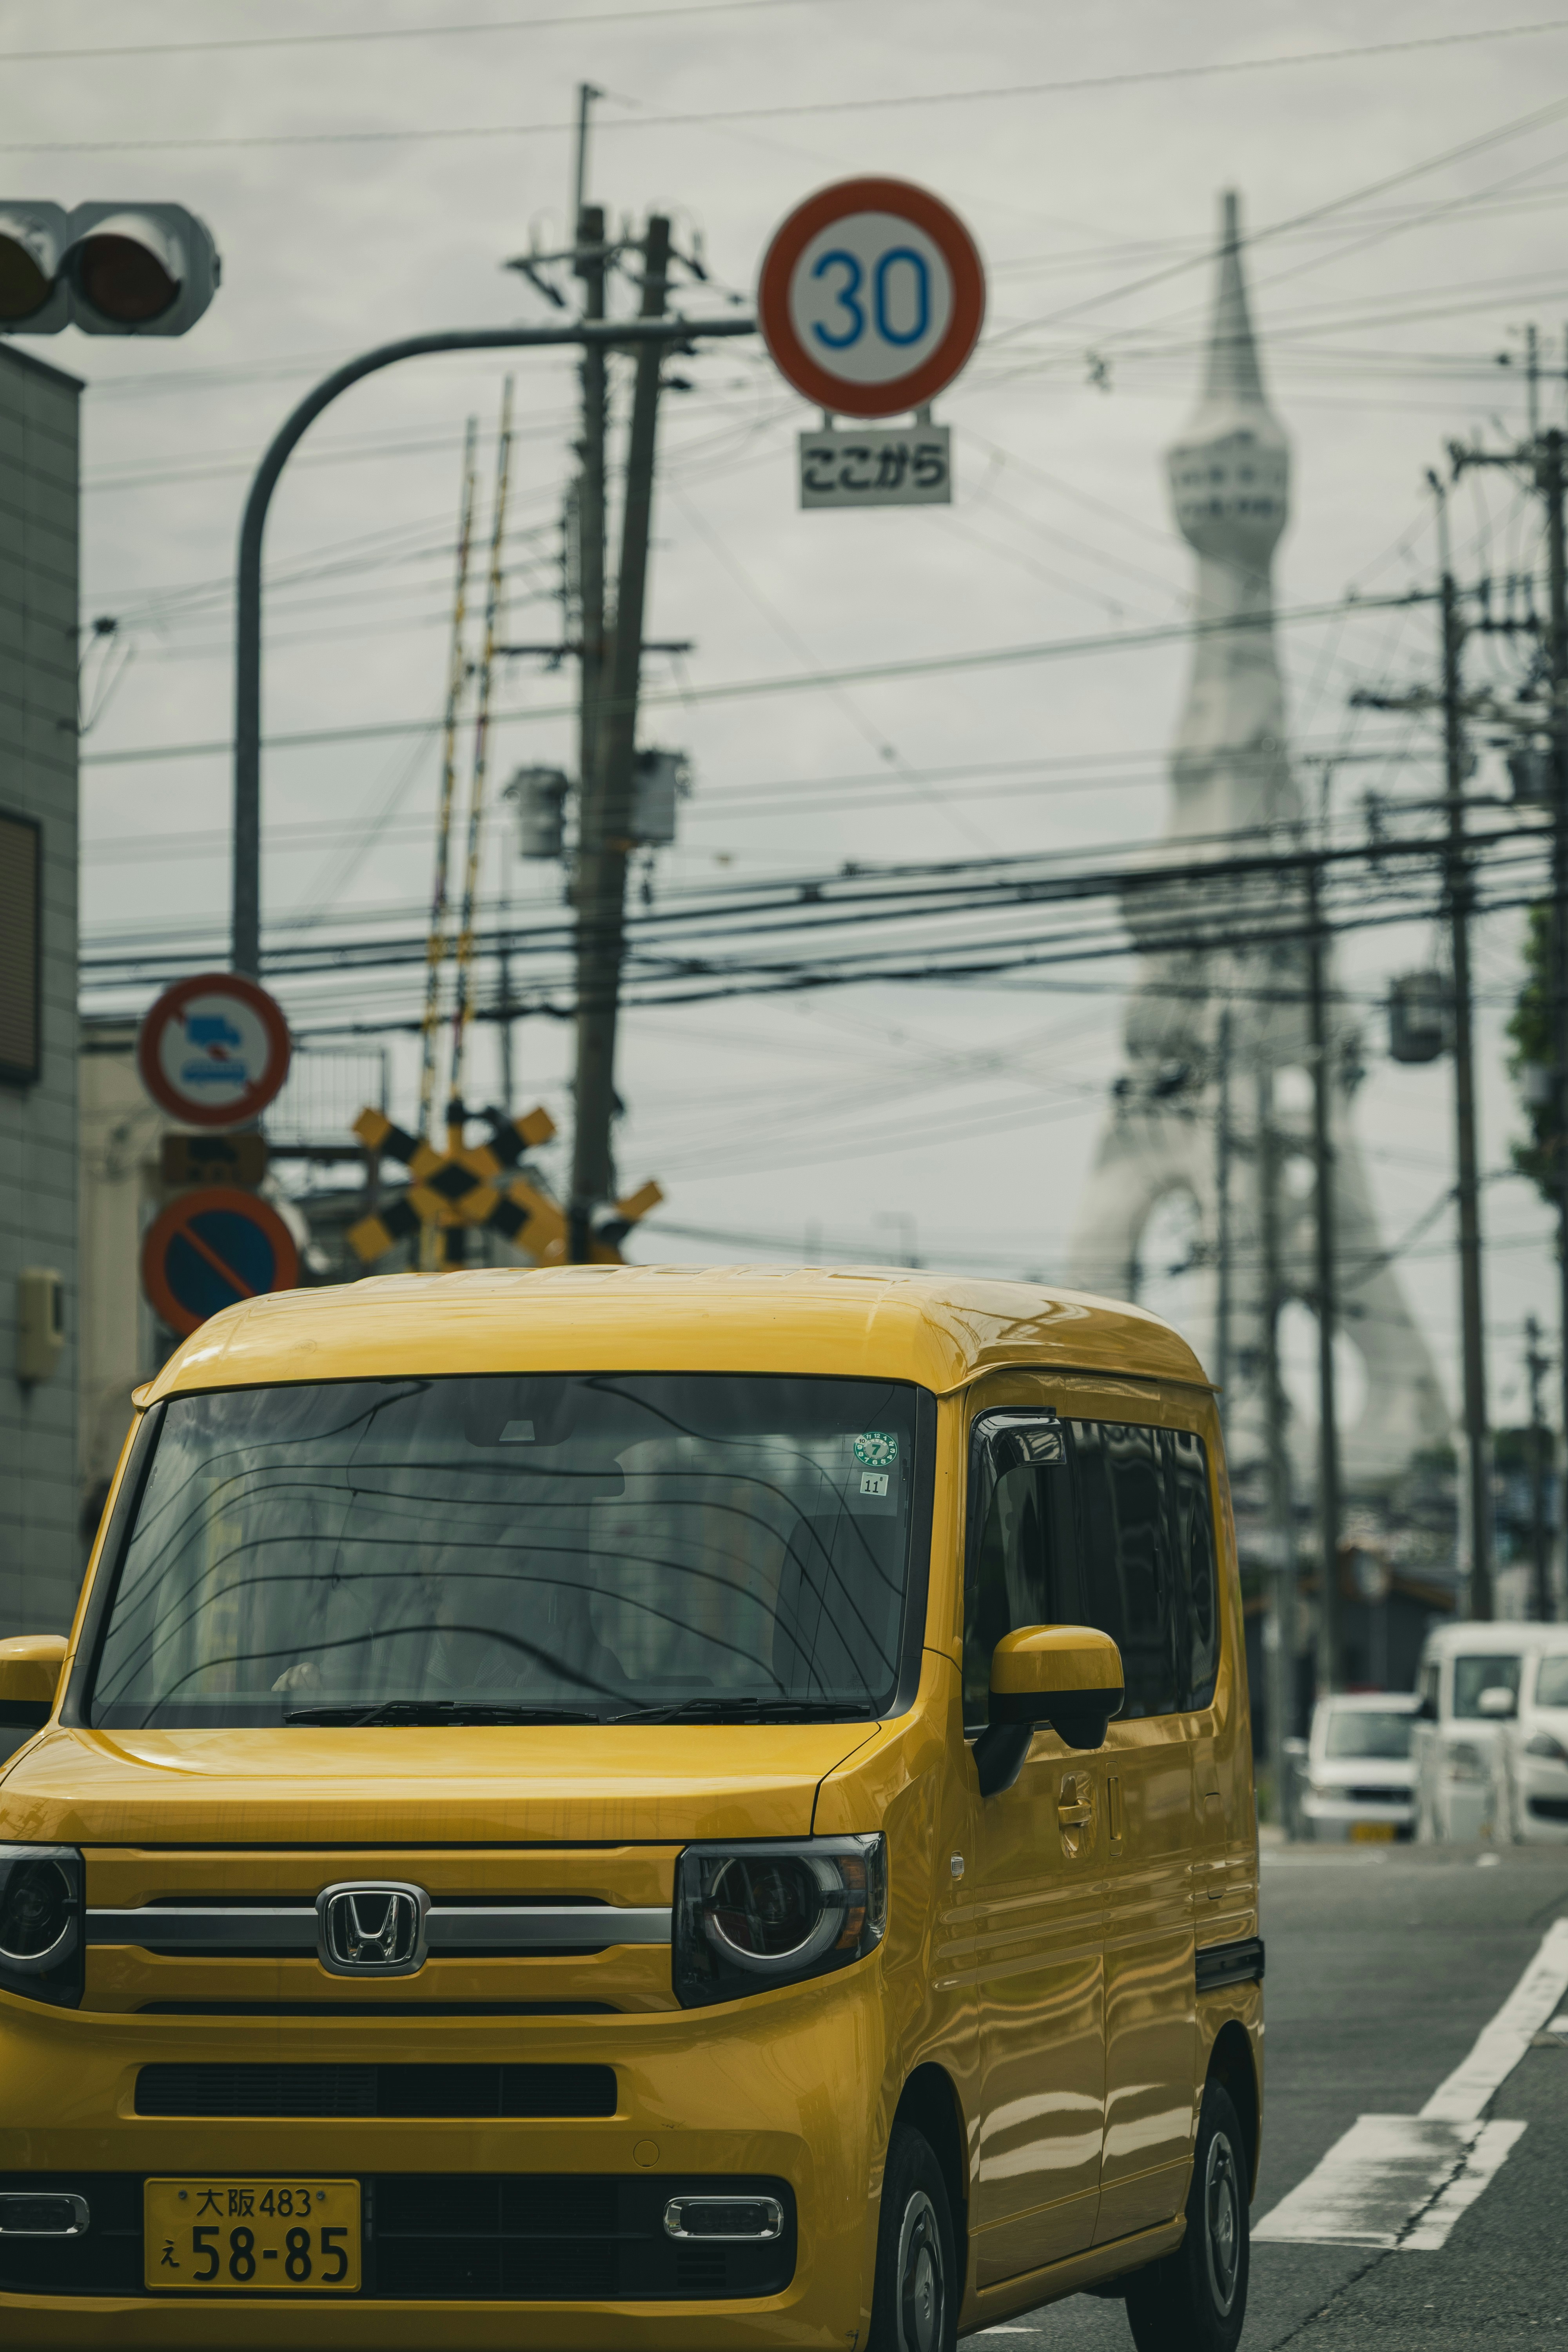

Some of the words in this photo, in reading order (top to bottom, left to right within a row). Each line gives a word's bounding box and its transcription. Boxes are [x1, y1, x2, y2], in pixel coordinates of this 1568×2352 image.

[811, 247, 931, 349] 30
[804, 443, 947, 490] ここから
[872, 1444, 881, 1455] 7
[865, 1480, 878, 1493] 11
[161, 2239, 180, 2267] え
[192, 2225, 348, 2282] 58-85
